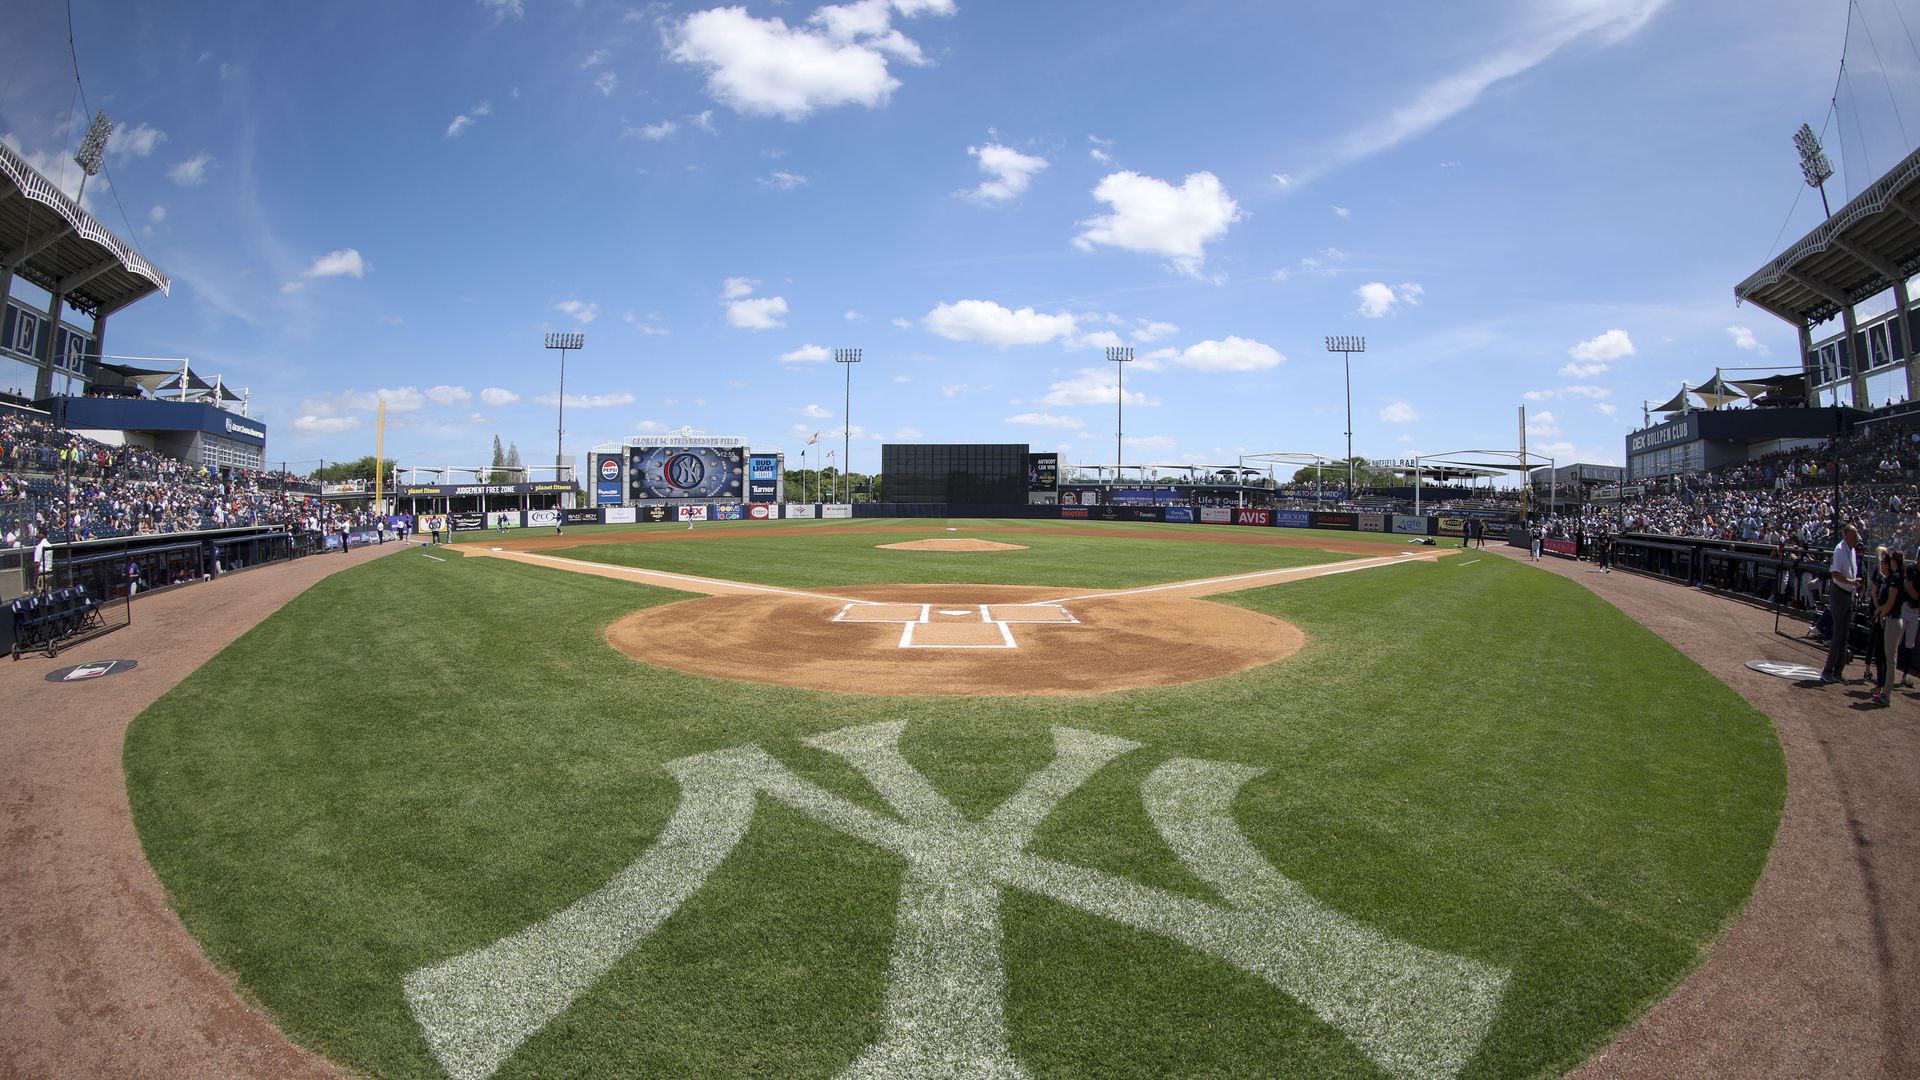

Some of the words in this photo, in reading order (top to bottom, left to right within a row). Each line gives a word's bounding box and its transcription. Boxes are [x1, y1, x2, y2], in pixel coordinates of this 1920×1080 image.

[632, 437, 658, 445] GEORGE
[670, 437, 719, 446] STEINBRENNER
[720, 437, 739, 446] FIELD
[1632, 434, 1646, 451] DEX
[1647, 428, 1671, 447] BULLPEN
[1672, 422, 1688, 440] CLUB
[455, 487, 485, 495] JUDGEMENT
[486, 486, 500, 494] FREE
[501, 485, 515, 493] ZONE
[752, 485, 775, 493] Turner
[1198, 496, 1213, 504] Life
[1222, 497, 1248, 505] Guad
[1239, 512, 1266, 523] AVIS
[403, 718, 1514, 1080] NY
